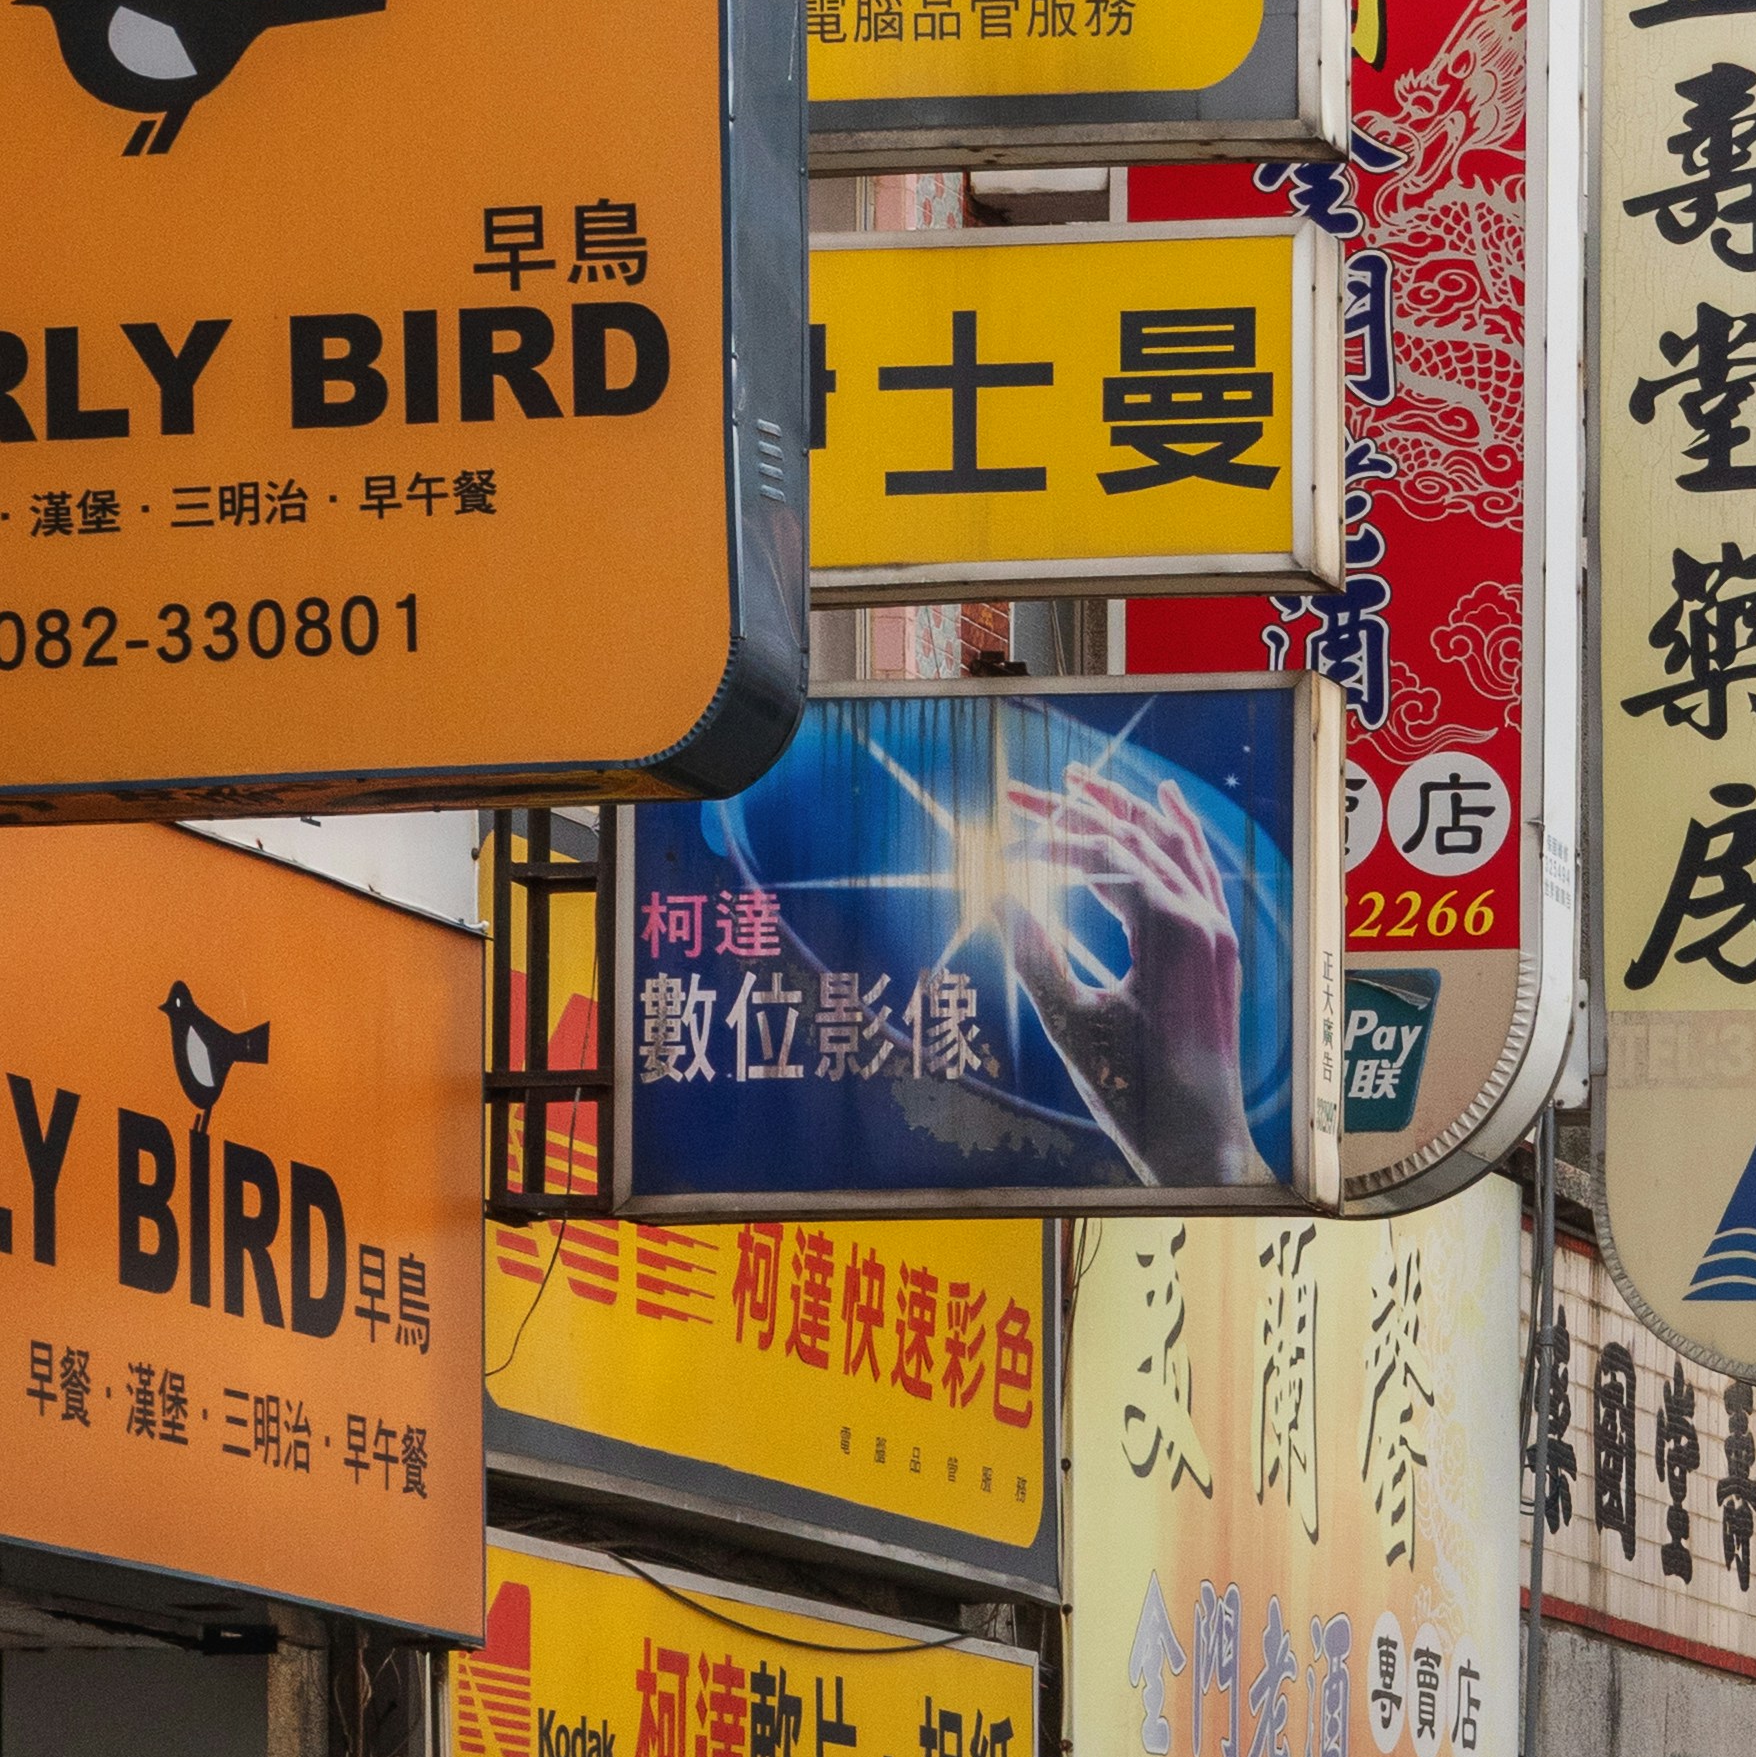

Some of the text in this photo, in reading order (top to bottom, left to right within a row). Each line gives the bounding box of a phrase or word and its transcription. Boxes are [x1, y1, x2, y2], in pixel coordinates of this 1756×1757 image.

[472, 197, 649, 292] 早鳥
[288, 300, 671, 430] BIRD
[809, 306, 1281, 497] 士曼
[641, 889, 781, 960] 柯達
[1345, 887, 1496, 938] 2266
[640, 968, 1001, 1083] 數位影像
[118, 1107, 347, 1340] BIRD
[353, 1243, 431, 1356] 早鳥
[731, 1221, 1035, 1431] 柯達快速彩色
[1370, 1633, 1483, 1754] 專賣店
